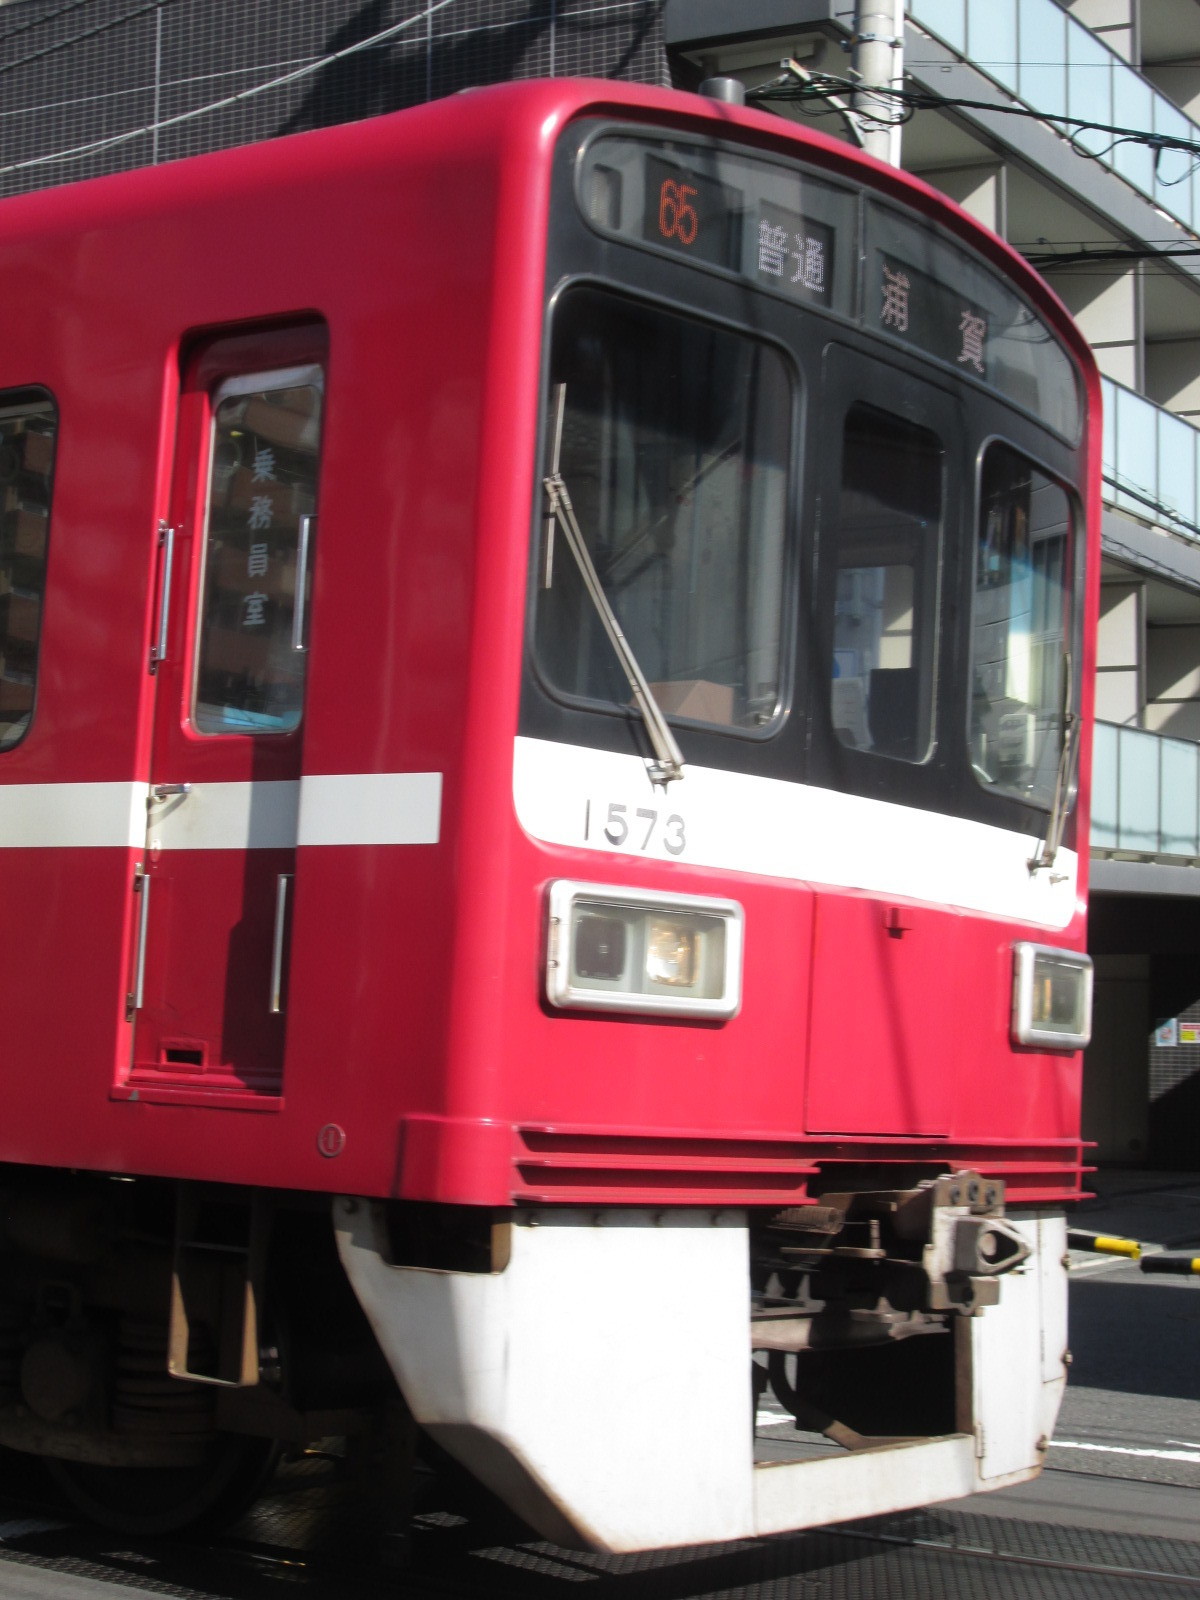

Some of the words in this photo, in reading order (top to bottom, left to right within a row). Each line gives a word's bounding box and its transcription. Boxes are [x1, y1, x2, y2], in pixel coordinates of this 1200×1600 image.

[659, 179, 698, 245] 65
[759, 219, 825, 293] 普通
[242, 448, 276, 626] 乗務員室
[584, 799, 686, 855] 1573
